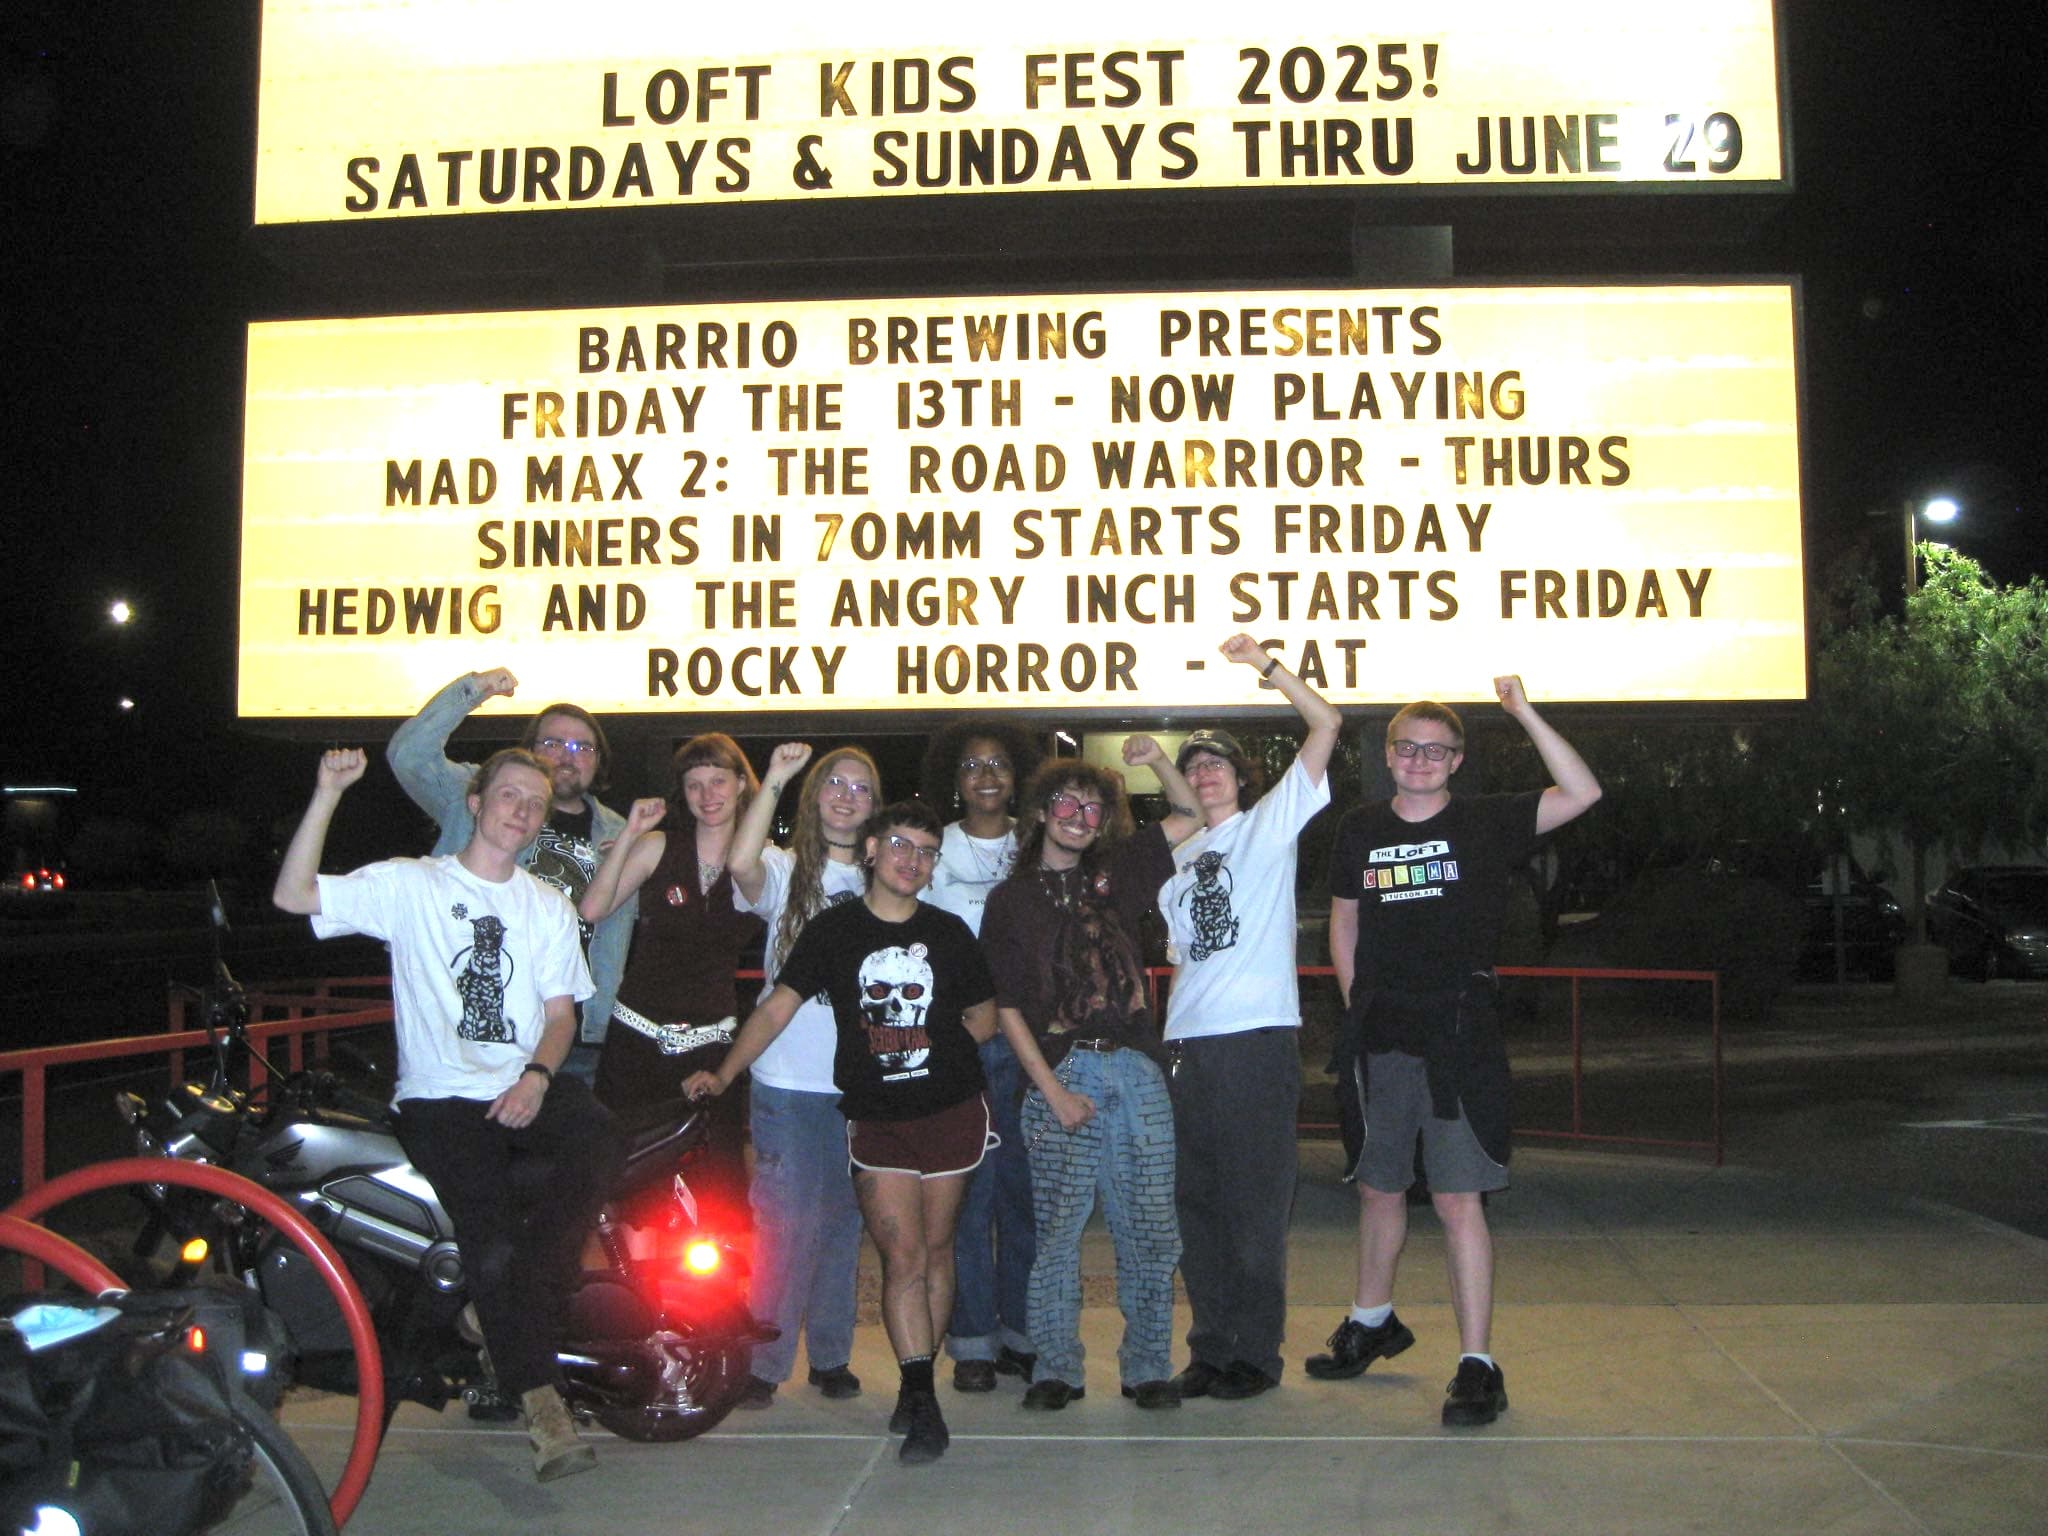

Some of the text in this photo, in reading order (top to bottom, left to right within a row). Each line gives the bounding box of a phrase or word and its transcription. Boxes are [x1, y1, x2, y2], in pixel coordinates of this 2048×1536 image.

[603, 44, 1438, 127] LOFT KIDS FEST 2025!
[346, 112, 1743, 212] SATURDAYS & SUNDAYS THRU JUNE 29
[579, 306, 1441, 373] BARRIO BREWING PRESENTS
[504, 371, 1524, 439] FRIDAY THE 13TH - NOW PLAYING
[386, 436, 1630, 506] MAD MAX 2: THE ROAD WARRIOR - THURS
[478, 504, 1491, 569] SINNERS IN 70MM STARTS FRIDAY
[299, 569, 1712, 635] HEDWIG AND THE ANGRY INCH STARTS FRIDAY
[649, 646, 846, 697] ROCKY
[898, 642, 1138, 694] HORROR
[1187, 661, 1204, 670] -
[1376, 850, 1392, 859] THE
